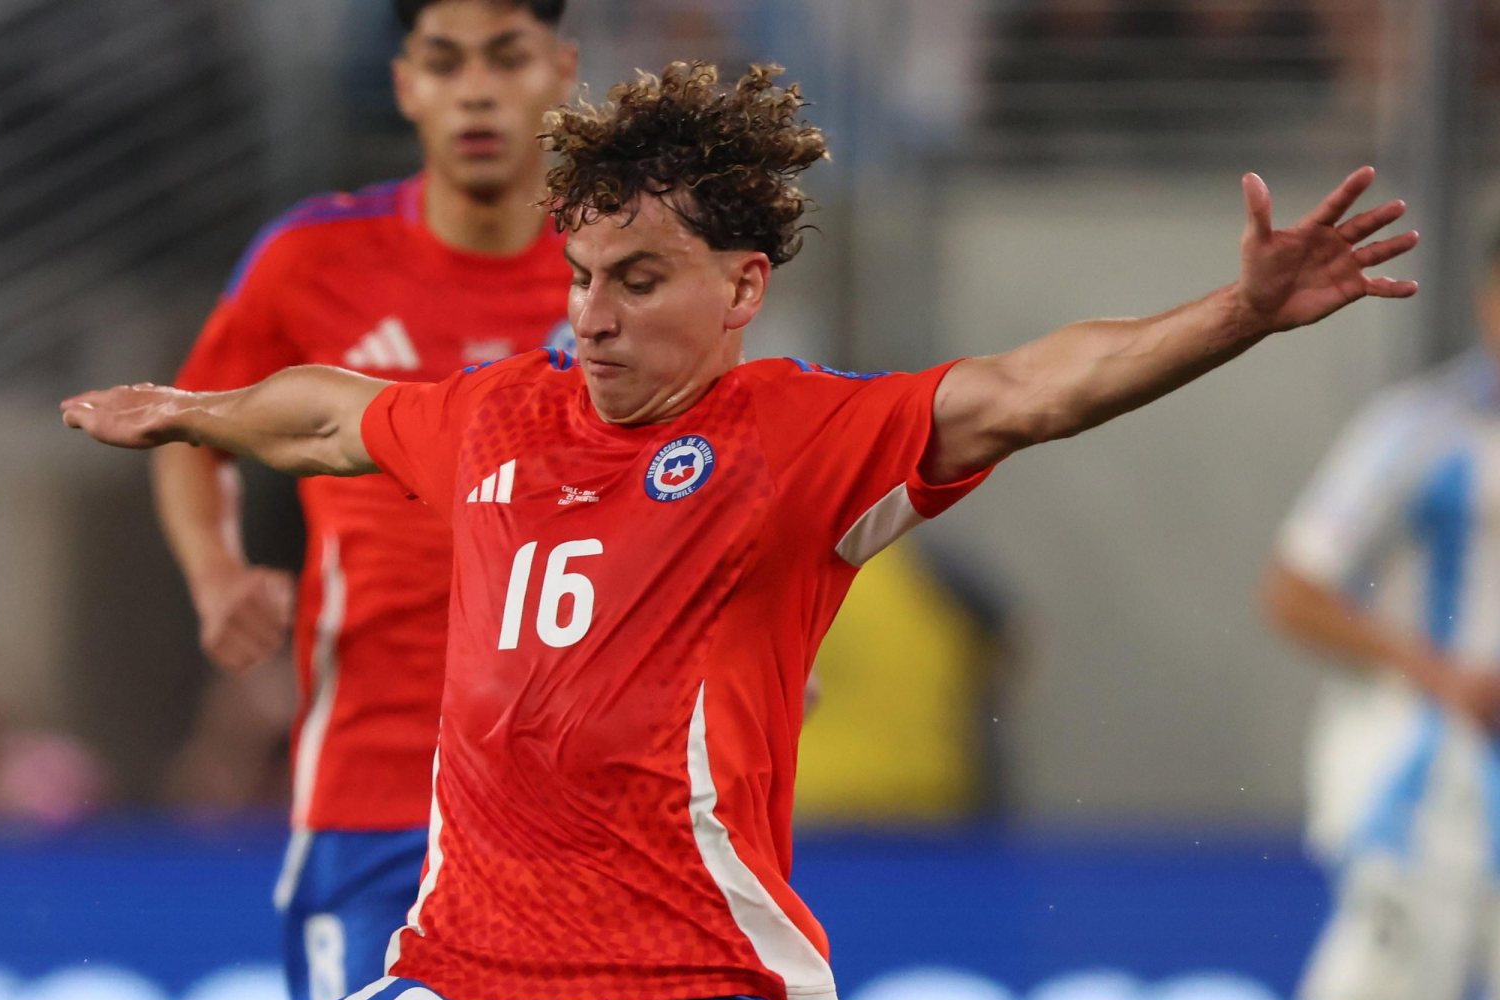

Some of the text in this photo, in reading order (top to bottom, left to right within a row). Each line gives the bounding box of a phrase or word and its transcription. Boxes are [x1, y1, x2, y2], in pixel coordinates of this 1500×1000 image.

[686, 437, 697, 446] DE
[657, 486, 694, 501] DE CHILE
[497, 538, 604, 650] 16
